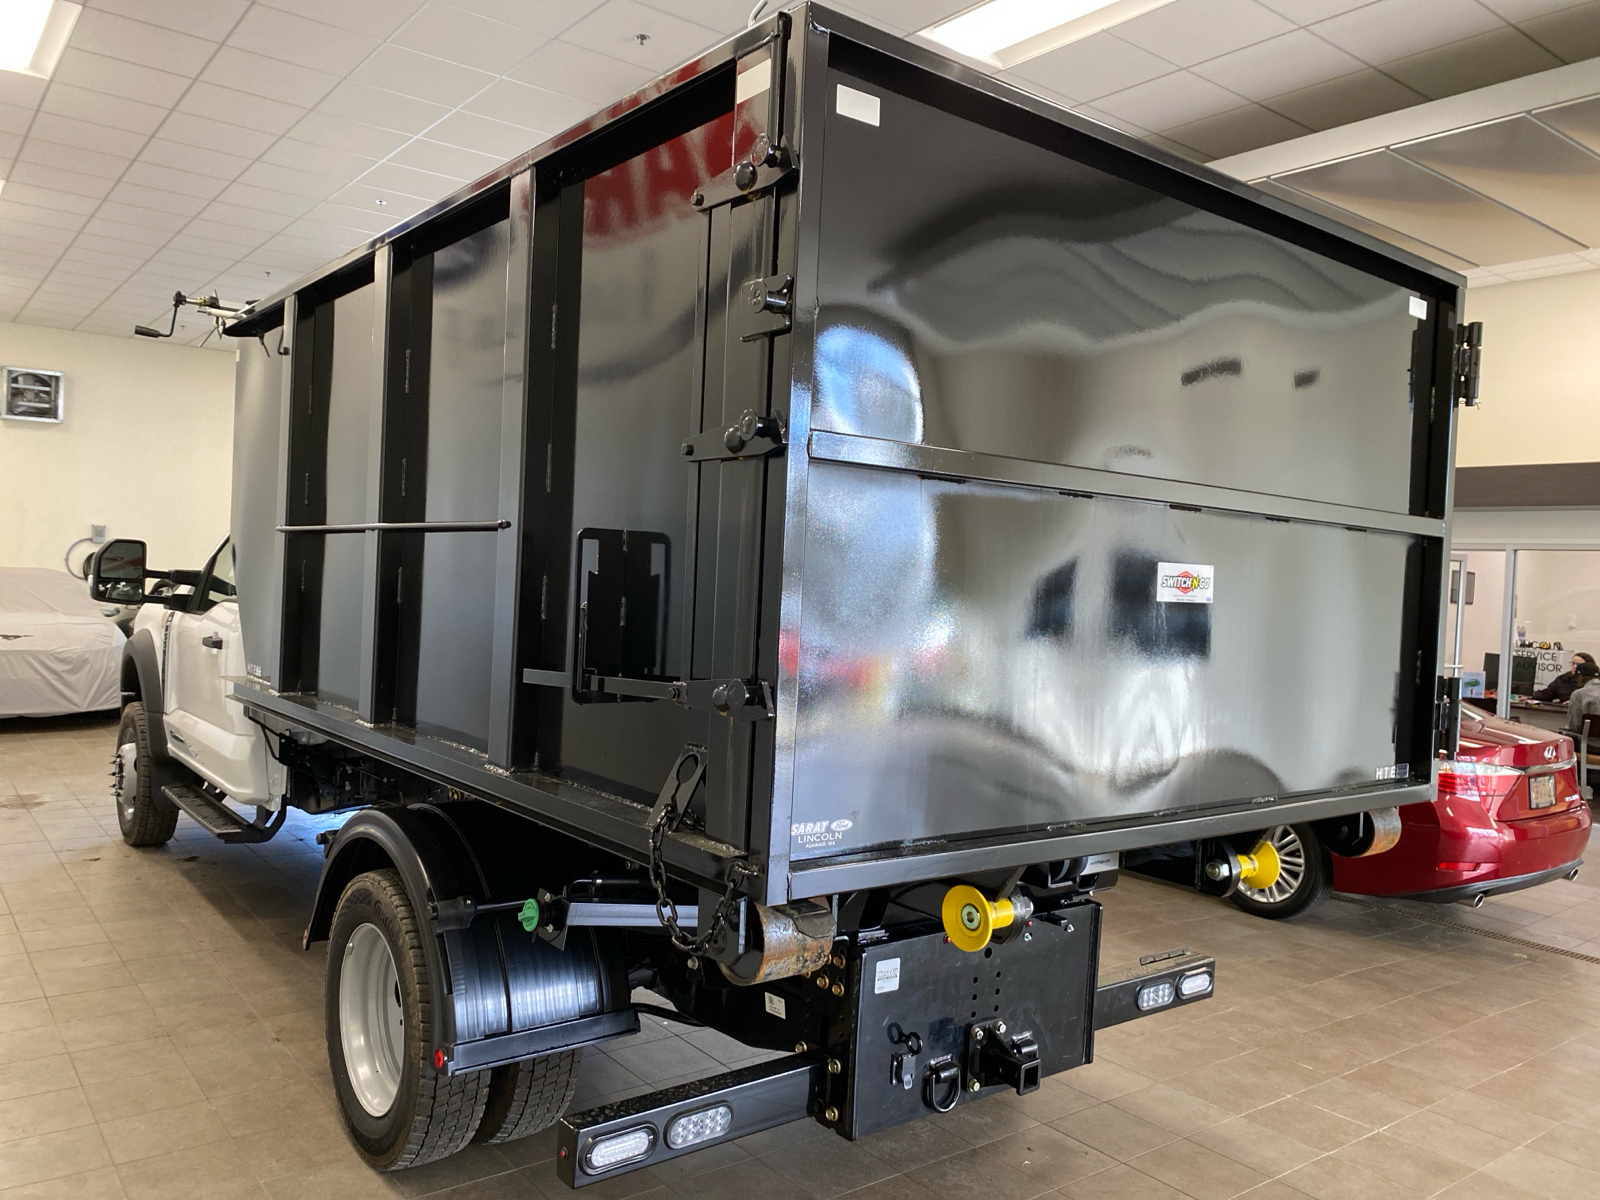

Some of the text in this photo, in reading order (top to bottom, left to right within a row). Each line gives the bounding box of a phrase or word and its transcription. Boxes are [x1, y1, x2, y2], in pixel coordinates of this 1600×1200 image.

[1515, 650, 1557, 662] SERVICE
[1515, 661, 1562, 672] ADVISOR
[791, 820, 850, 836] SARAT Ford
[798, 832, 842, 844] LINCOLN
